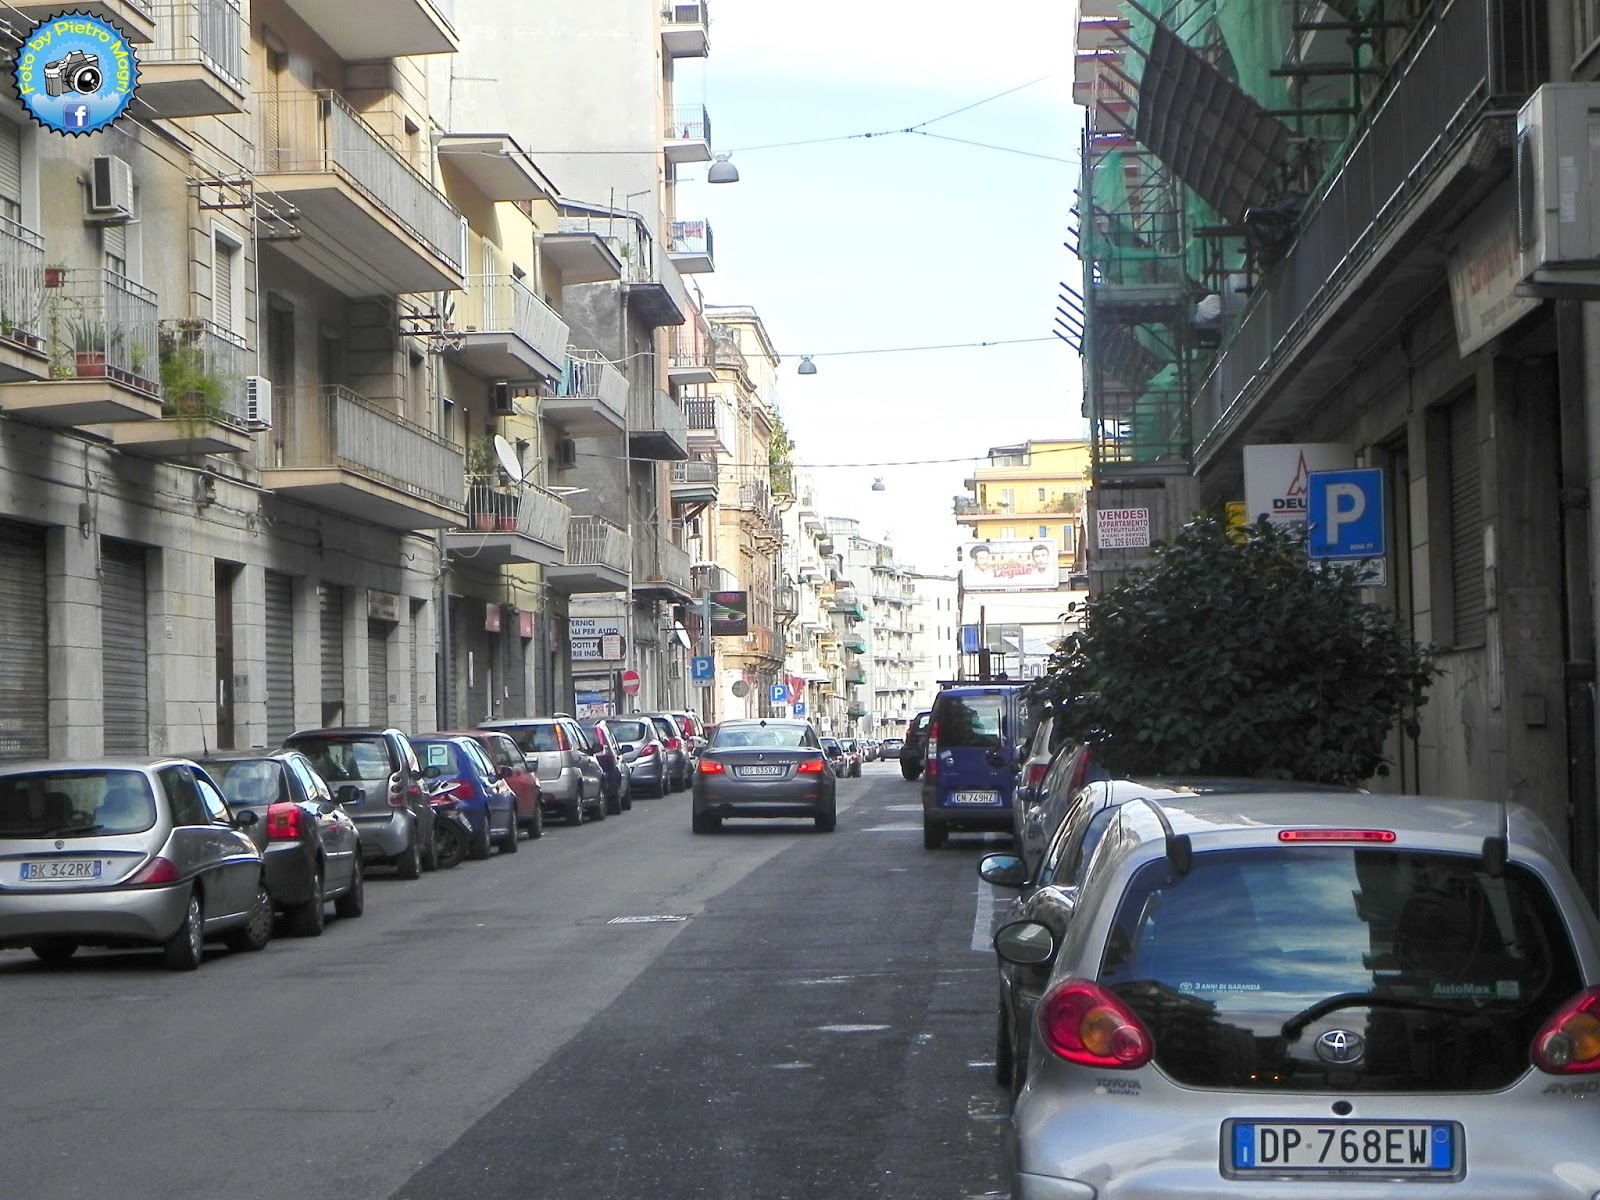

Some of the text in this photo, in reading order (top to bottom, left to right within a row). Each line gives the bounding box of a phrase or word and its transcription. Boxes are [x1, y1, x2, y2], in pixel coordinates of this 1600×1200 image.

[1326, 483, 1366, 545] P
[1099, 519, 1148, 528] APPARTAMENTO
[1102, 539, 1113, 547] TEL.
[992, 566, 1033, 578] Legale
[697, 659, 709, 677] P
[774, 687, 784, 699] P
[795, 703, 803, 712] P
[430, 746, 446, 764] P
[30, 864, 46, 877] BK
[51, 862, 92, 876] 342RK
[1433, 983, 1490, 994] AutoMax
[1096, 1078, 1142, 1089] TOYOTA
[1260, 1128, 1302, 1163] DP
[1317, 1128, 1427, 1163] 768EW
